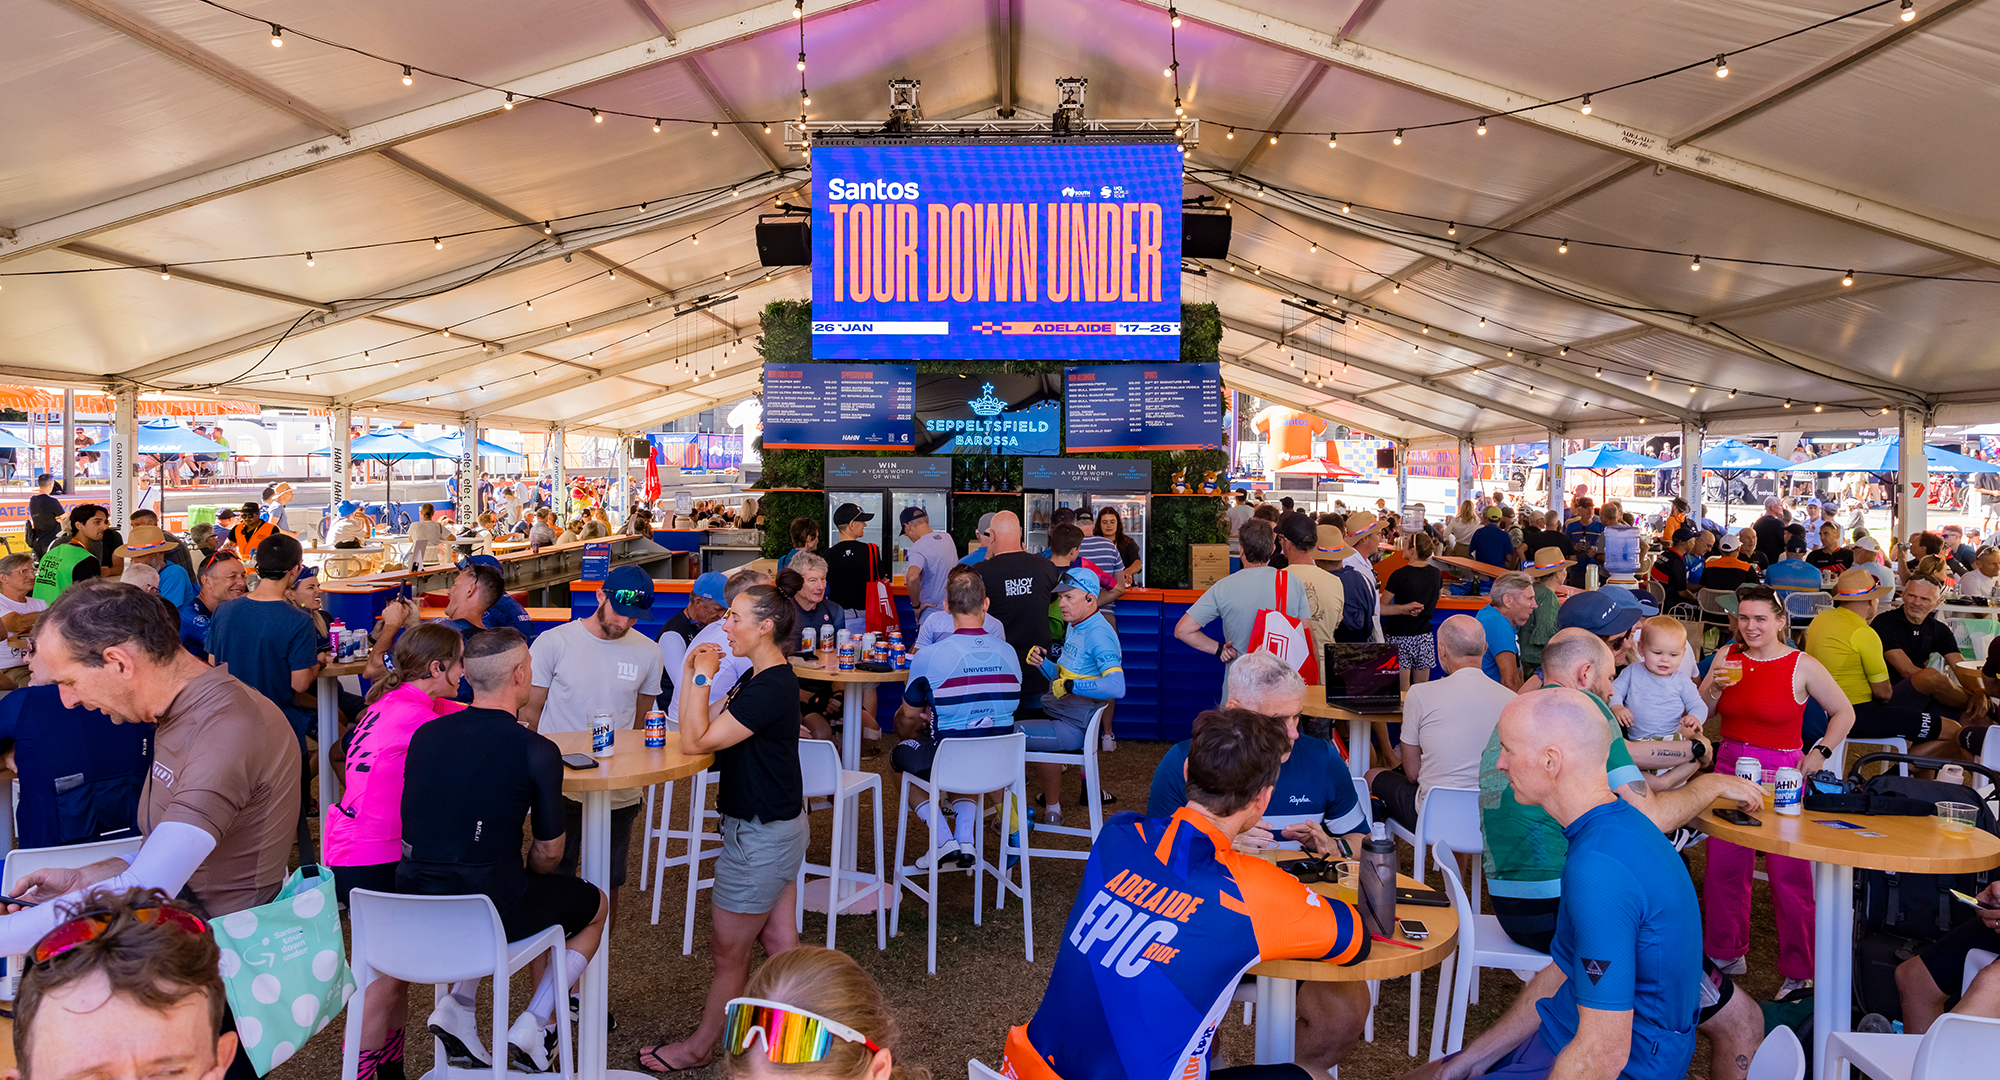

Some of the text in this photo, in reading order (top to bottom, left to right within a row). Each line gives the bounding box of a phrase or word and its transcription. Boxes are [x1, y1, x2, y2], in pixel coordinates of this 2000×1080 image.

[829, 178, 919, 200] Santos
[829, 202, 1163, 302] TOUR DOWN UNDER
[842, 323, 873, 332] JAN
[1032, 324, 1112, 333] ADELAIDE
[926, 420, 1049, 432] SEPPELTSFIELD
[955, 436, 1018, 446] BAROSSA
[334, 448, 342, 474] HAHN
[1004, 577, 1034, 588] ENJOY
[1010, 586, 1032, 596] RIDE
[963, 666, 1003, 674] UNIVERSITY
[593, 724, 610, 735] AHN
[1918, 712, 1931, 739] RAPHA
[1288, 794, 1312, 805] Rapha
[1104, 868, 1205, 924] ADELAIDE
[274, 925, 302, 940] Santos
[282, 932, 304, 945] tour
[1069, 890, 1179, 979] EPIC
[281, 940, 306, 954] down
[1142, 942, 1180, 965] RIDE
[282, 948, 308, 962] under
